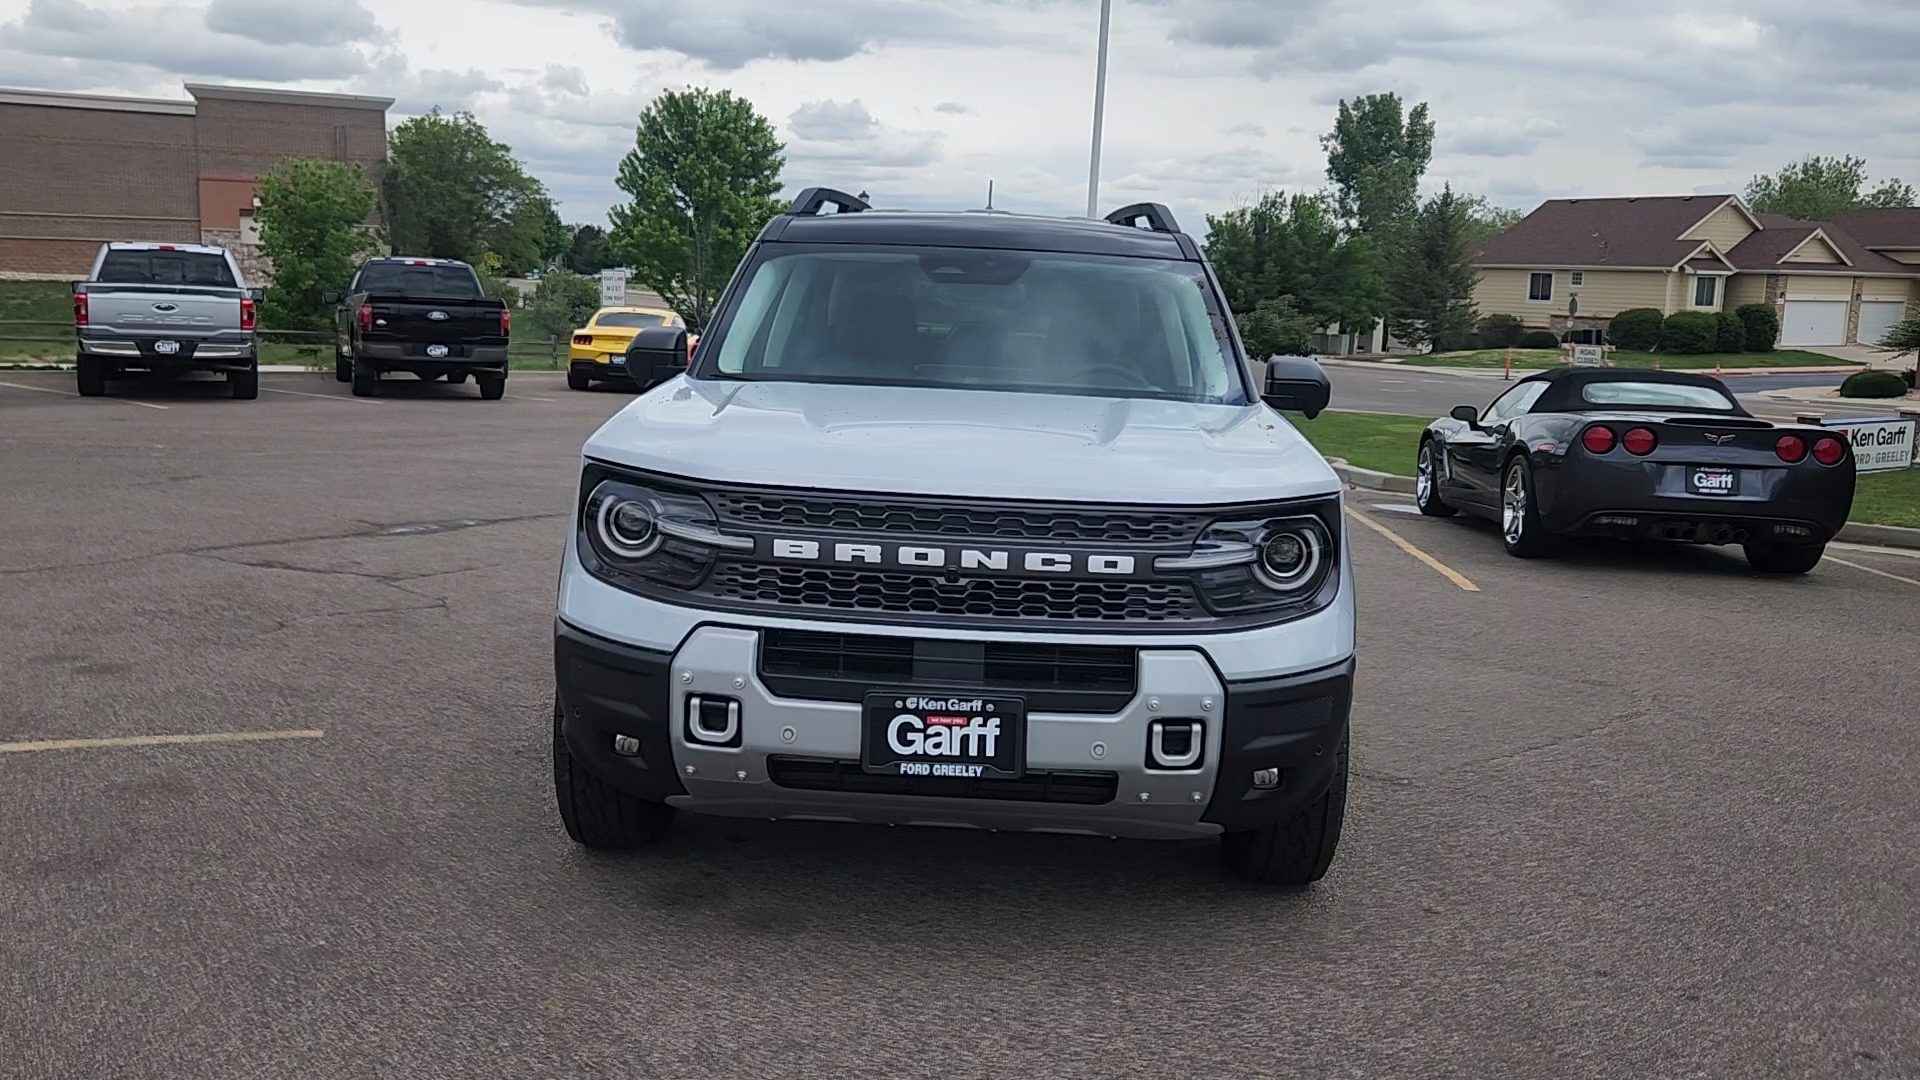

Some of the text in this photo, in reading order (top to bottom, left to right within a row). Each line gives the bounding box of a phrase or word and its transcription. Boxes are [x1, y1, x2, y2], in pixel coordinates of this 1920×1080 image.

[154, 342, 180, 354] Garff
[1851, 426, 1907, 448] Ken Garff
[1875, 450, 1910, 464] GREELEY
[1694, 472, 1734, 488] Garff
[773, 538, 1135, 574] BRONCO
[918, 697, 982, 712] Ken Garff
[887, 714, 1000, 757] Garff
[900, 763, 984, 776] FORD GREELEY
